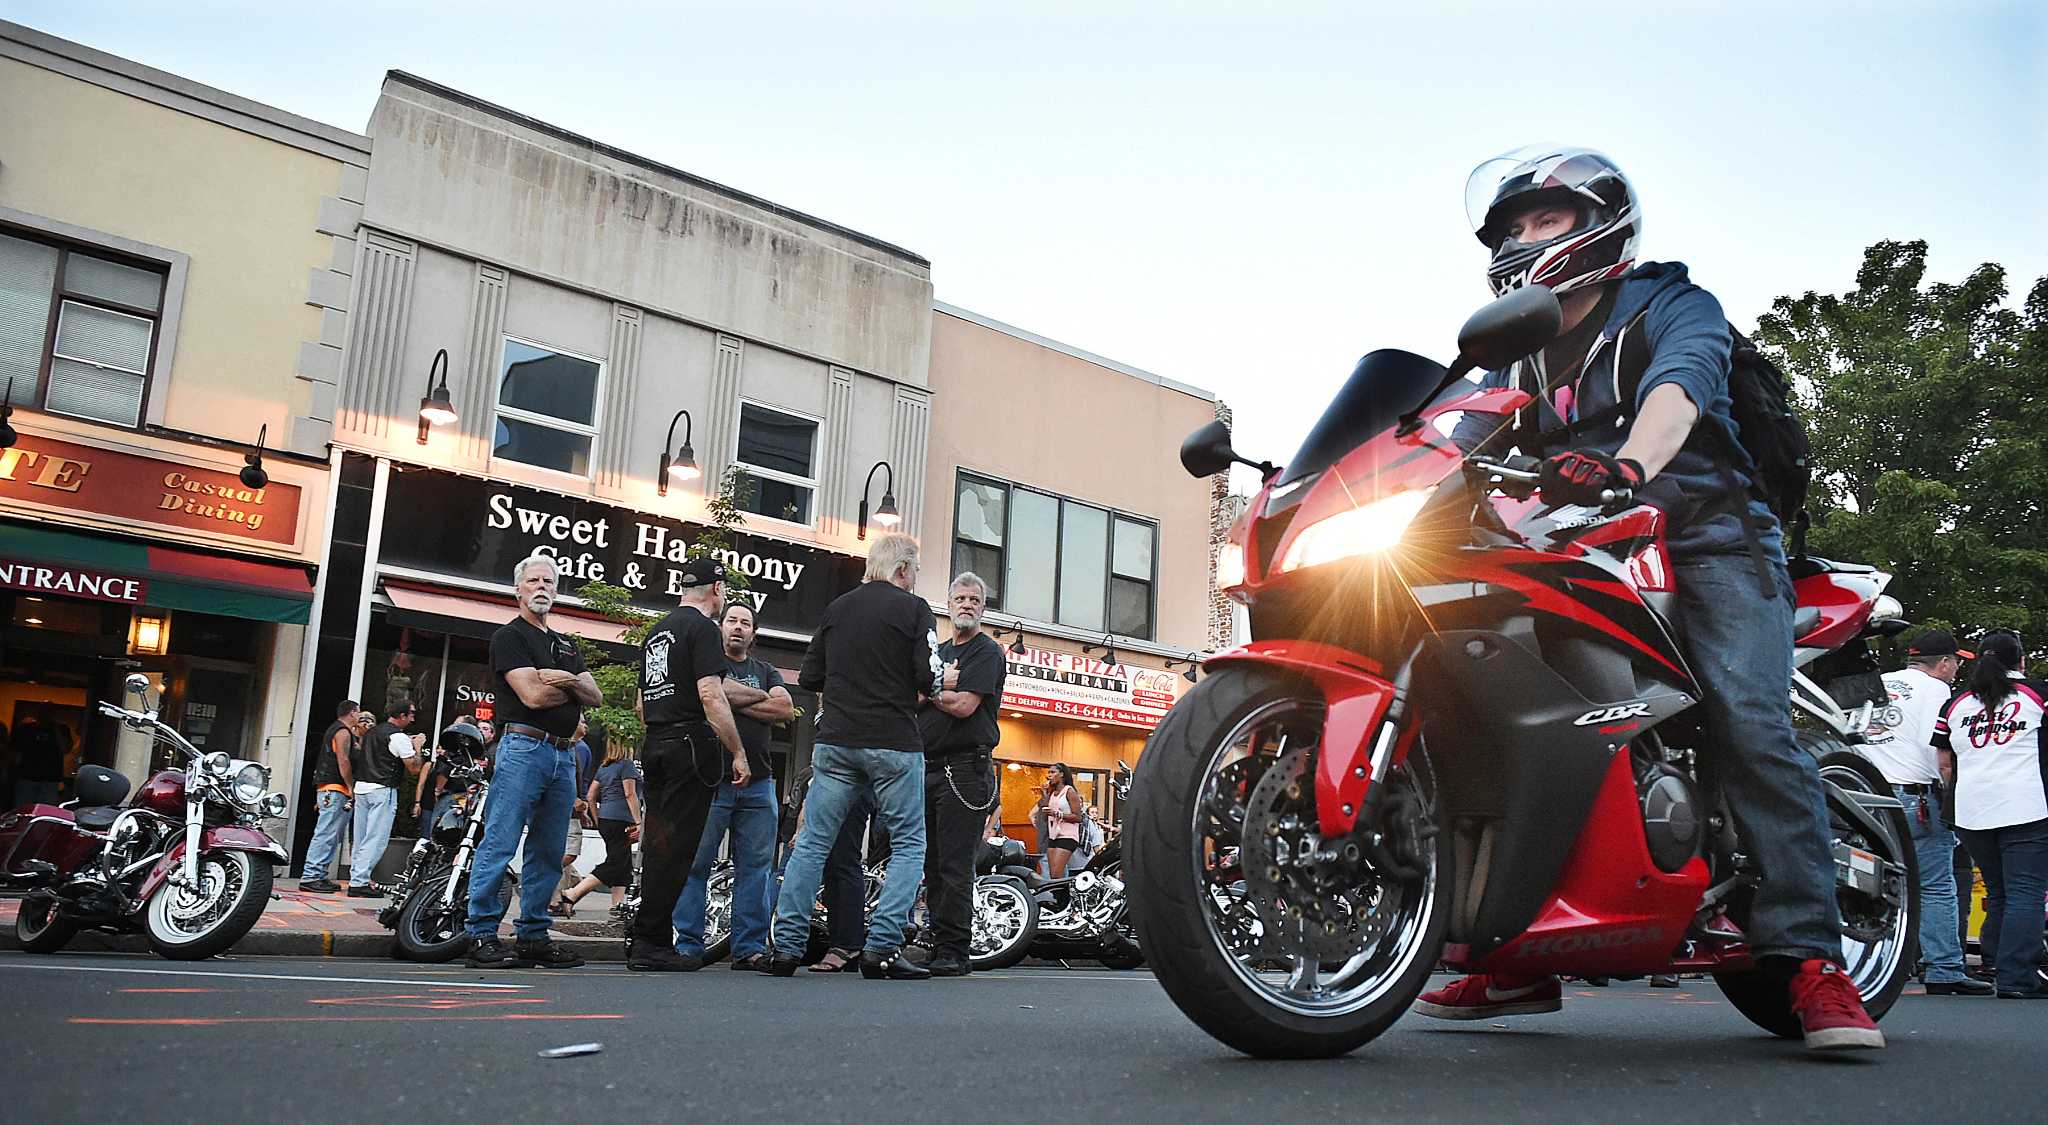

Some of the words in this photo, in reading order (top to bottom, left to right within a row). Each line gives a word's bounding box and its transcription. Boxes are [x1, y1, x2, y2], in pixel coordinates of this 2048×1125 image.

[163, 472, 266, 504] Casual
[157, 493, 264, 530] Dining
[1555, 515, 1608, 530] HONDA
[487, 494, 610, 548] Sweet
[632, 522, 805, 591] Hamony
[622, 561, 647, 590] &
[1071, 656, 1127, 679] PIZZA
[1054, 701, 1114, 719] 854-6444
[1573, 702, 1653, 726] CBR
